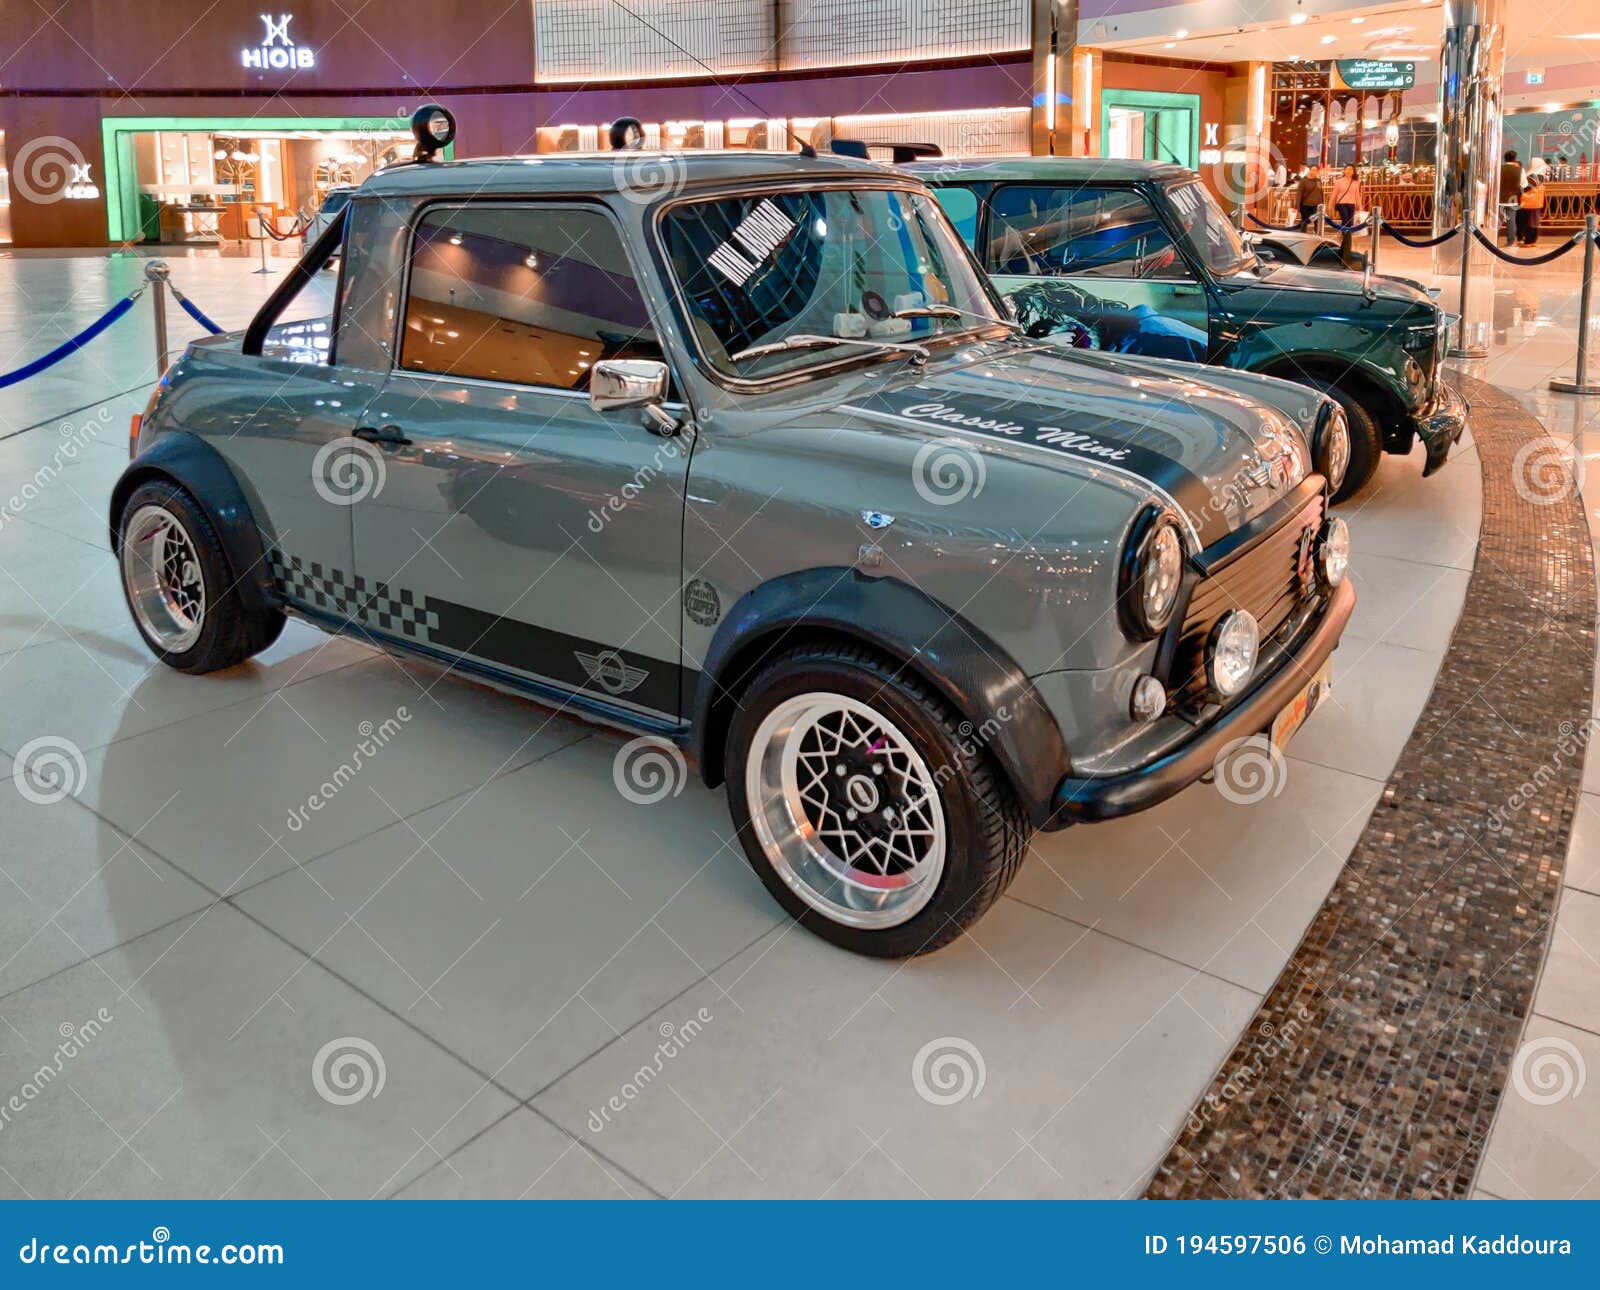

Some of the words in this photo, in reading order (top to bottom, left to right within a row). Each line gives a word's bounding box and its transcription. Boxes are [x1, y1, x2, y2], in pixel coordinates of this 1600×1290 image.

[707, 198, 797, 288] MINI_ABUDHABI
[902, 403, 1025, 436] Classic
[1037, 426, 1132, 460] Mini
